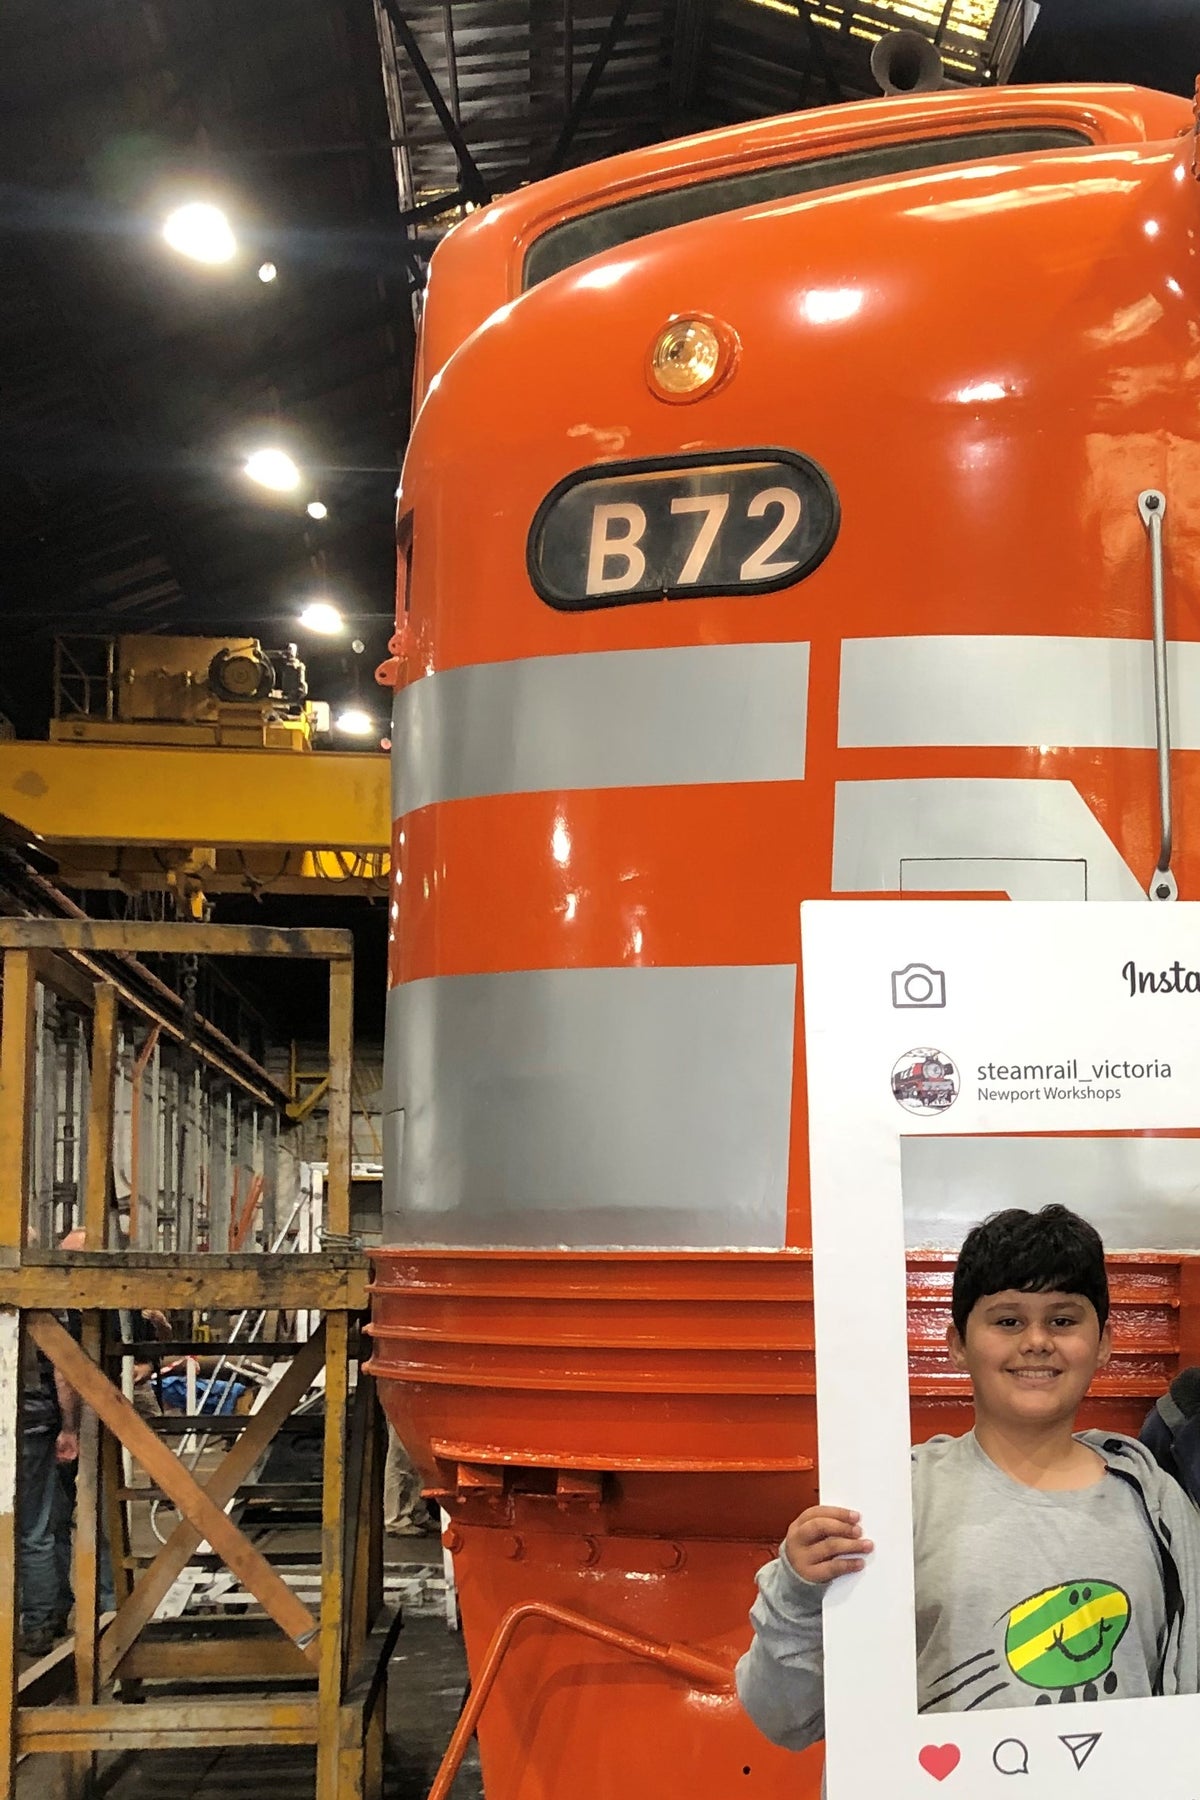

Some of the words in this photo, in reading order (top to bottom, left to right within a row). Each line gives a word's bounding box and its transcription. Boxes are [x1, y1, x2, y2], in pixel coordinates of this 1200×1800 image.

[977, 1060, 1172, 1083] steamrail_victoria
[977, 1086, 1041, 1103] Newport
[1043, 1085, 1122, 1102] Workshops
